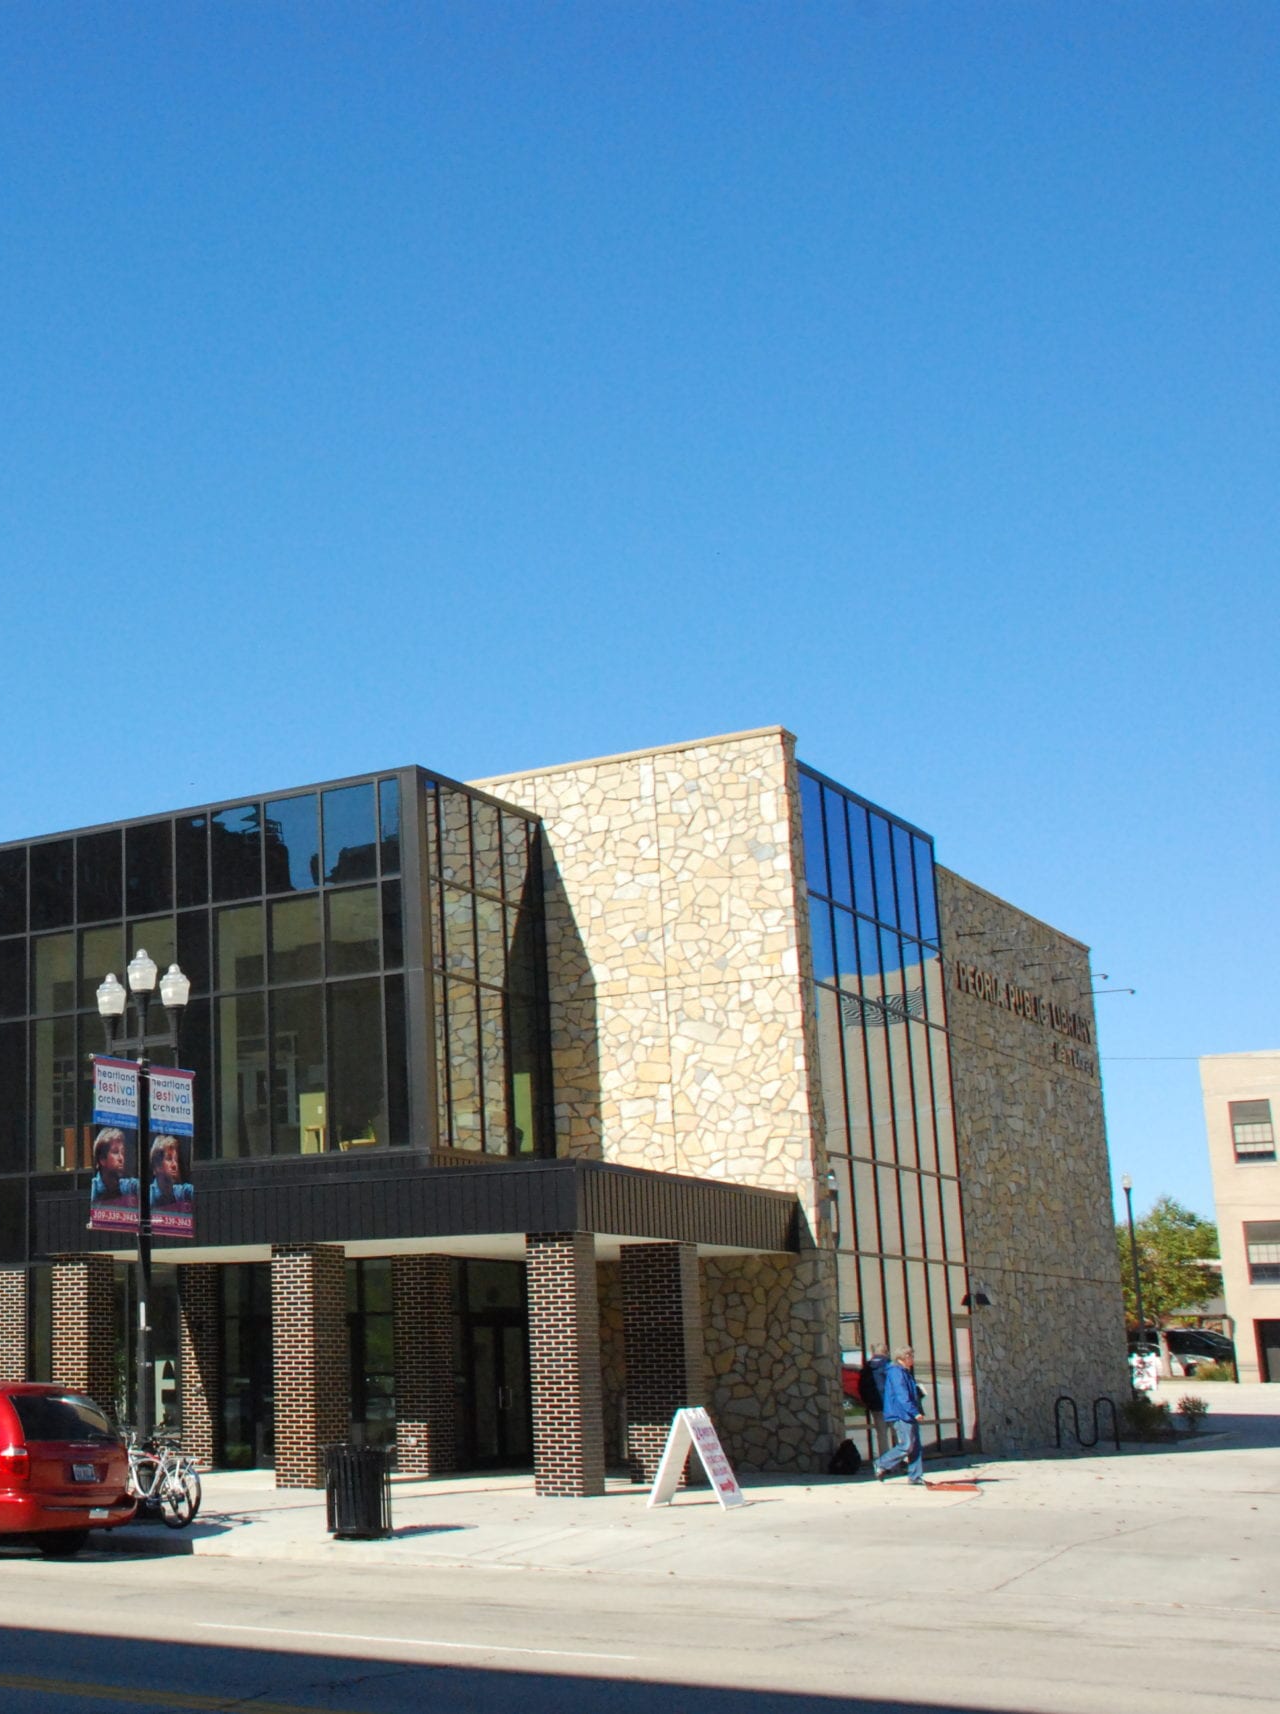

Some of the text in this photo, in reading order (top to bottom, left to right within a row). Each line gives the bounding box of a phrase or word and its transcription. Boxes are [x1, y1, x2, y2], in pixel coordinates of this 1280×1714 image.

[955, 960, 1091, 1044] PEORIA PUBLIC LIBRARY
[97, 1067, 136, 1082] heartland
[98, 1080, 135, 1096] festival
[97, 1094, 136, 1108] orchestra
[153, 1089, 190, 1104] festival
[152, 1102, 191, 1115] orchestra
